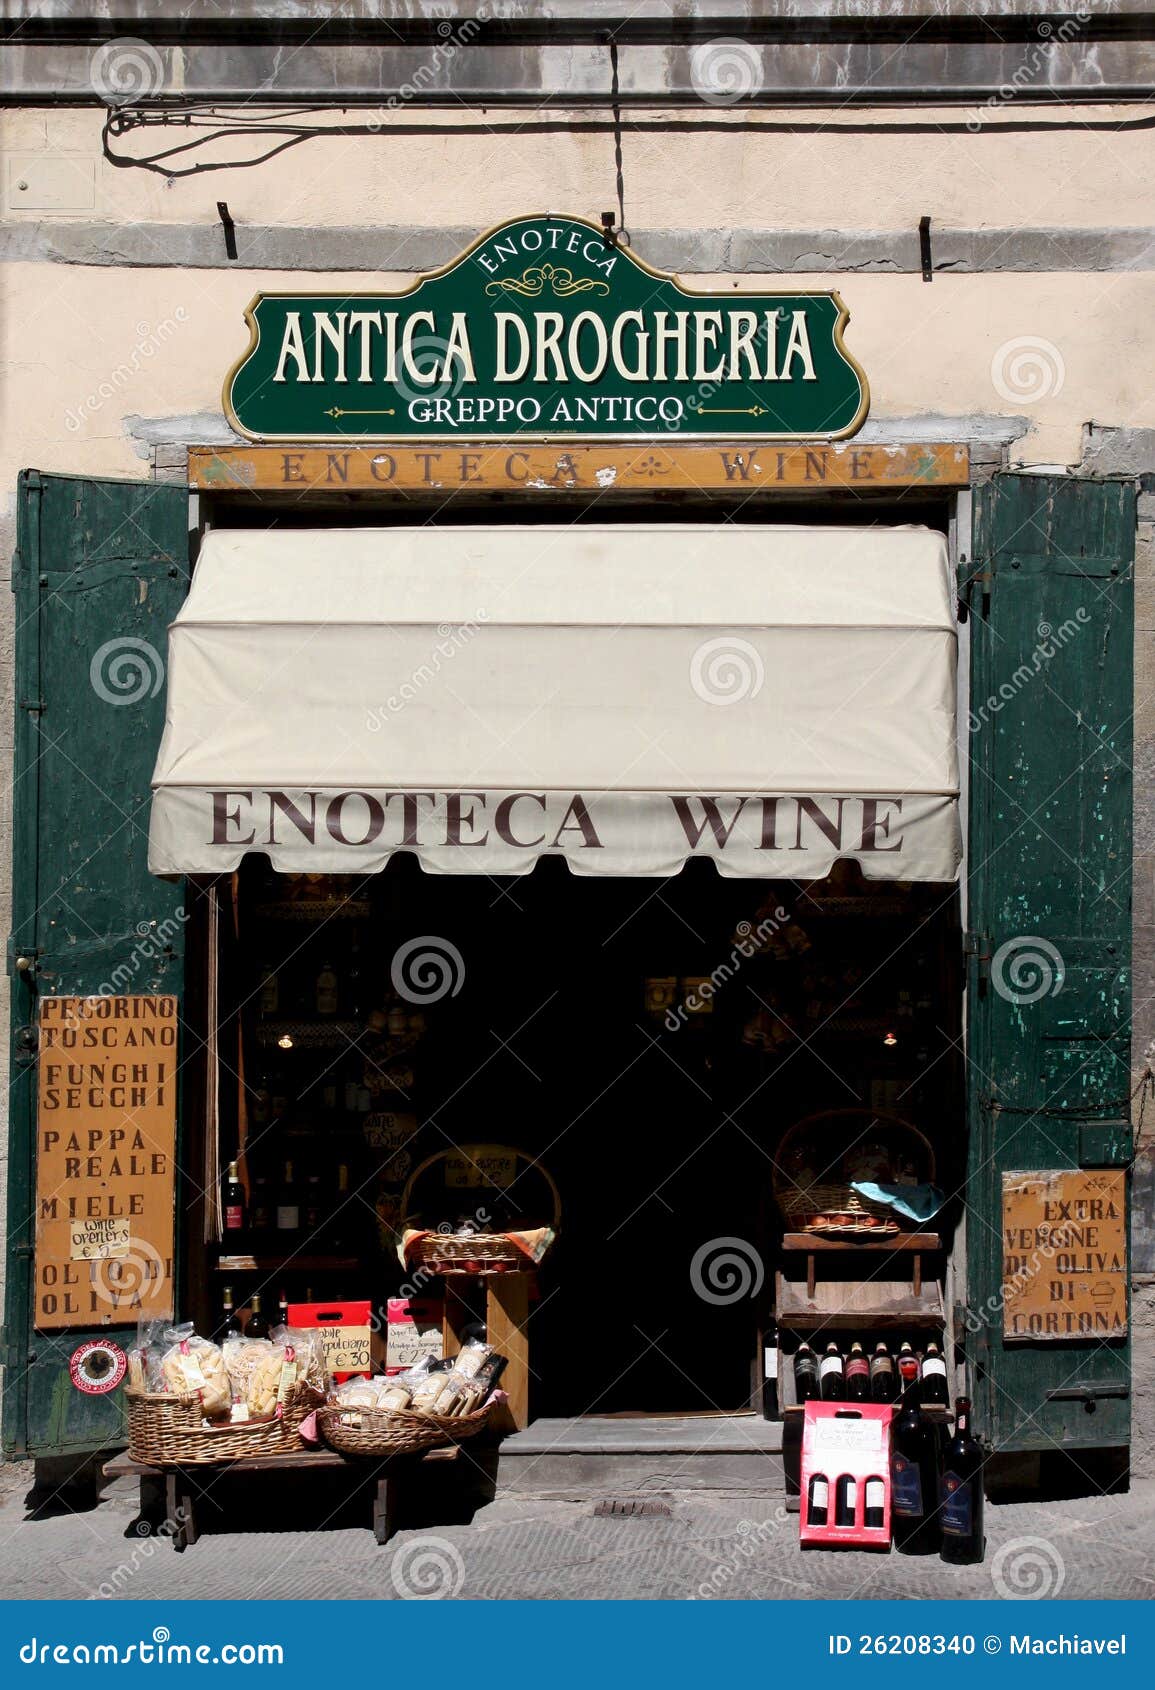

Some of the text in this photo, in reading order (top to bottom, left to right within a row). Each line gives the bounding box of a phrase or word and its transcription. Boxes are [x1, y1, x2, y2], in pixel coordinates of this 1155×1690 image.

[477, 229, 618, 277] ENOTECA
[273, 310, 816, 383] ANTICA DROGHERIA
[408, 397, 684, 426] GREPPO ANTICO
[281, 451, 874, 483] ENOTECA WINE
[205, 791, 905, 852] ENOTECA WINE
[42, 998, 173, 1020] PECORINO
[42, 1026, 175, 1048] TOSCANO
[45, 1062, 166, 1086] FUNGHI
[43, 1086, 165, 1110] SECCHI
[43, 1129, 145, 1153] PAPPA
[65, 1153, 167, 1179] REALE
[40, 1194, 145, 1220] MIELE
[1044, 1199, 1119, 1221] EXTRA
[1005, 1227, 1099, 1249] VERGINE
[42, 1257, 173, 1286] OLIO DI
[1005, 1252, 1122, 1276] DI OLIVA
[42, 1289, 143, 1315] OLIVA
[1050, 1281, 1074, 1302] DI
[1012, 1312, 1123, 1334] CORTONA
